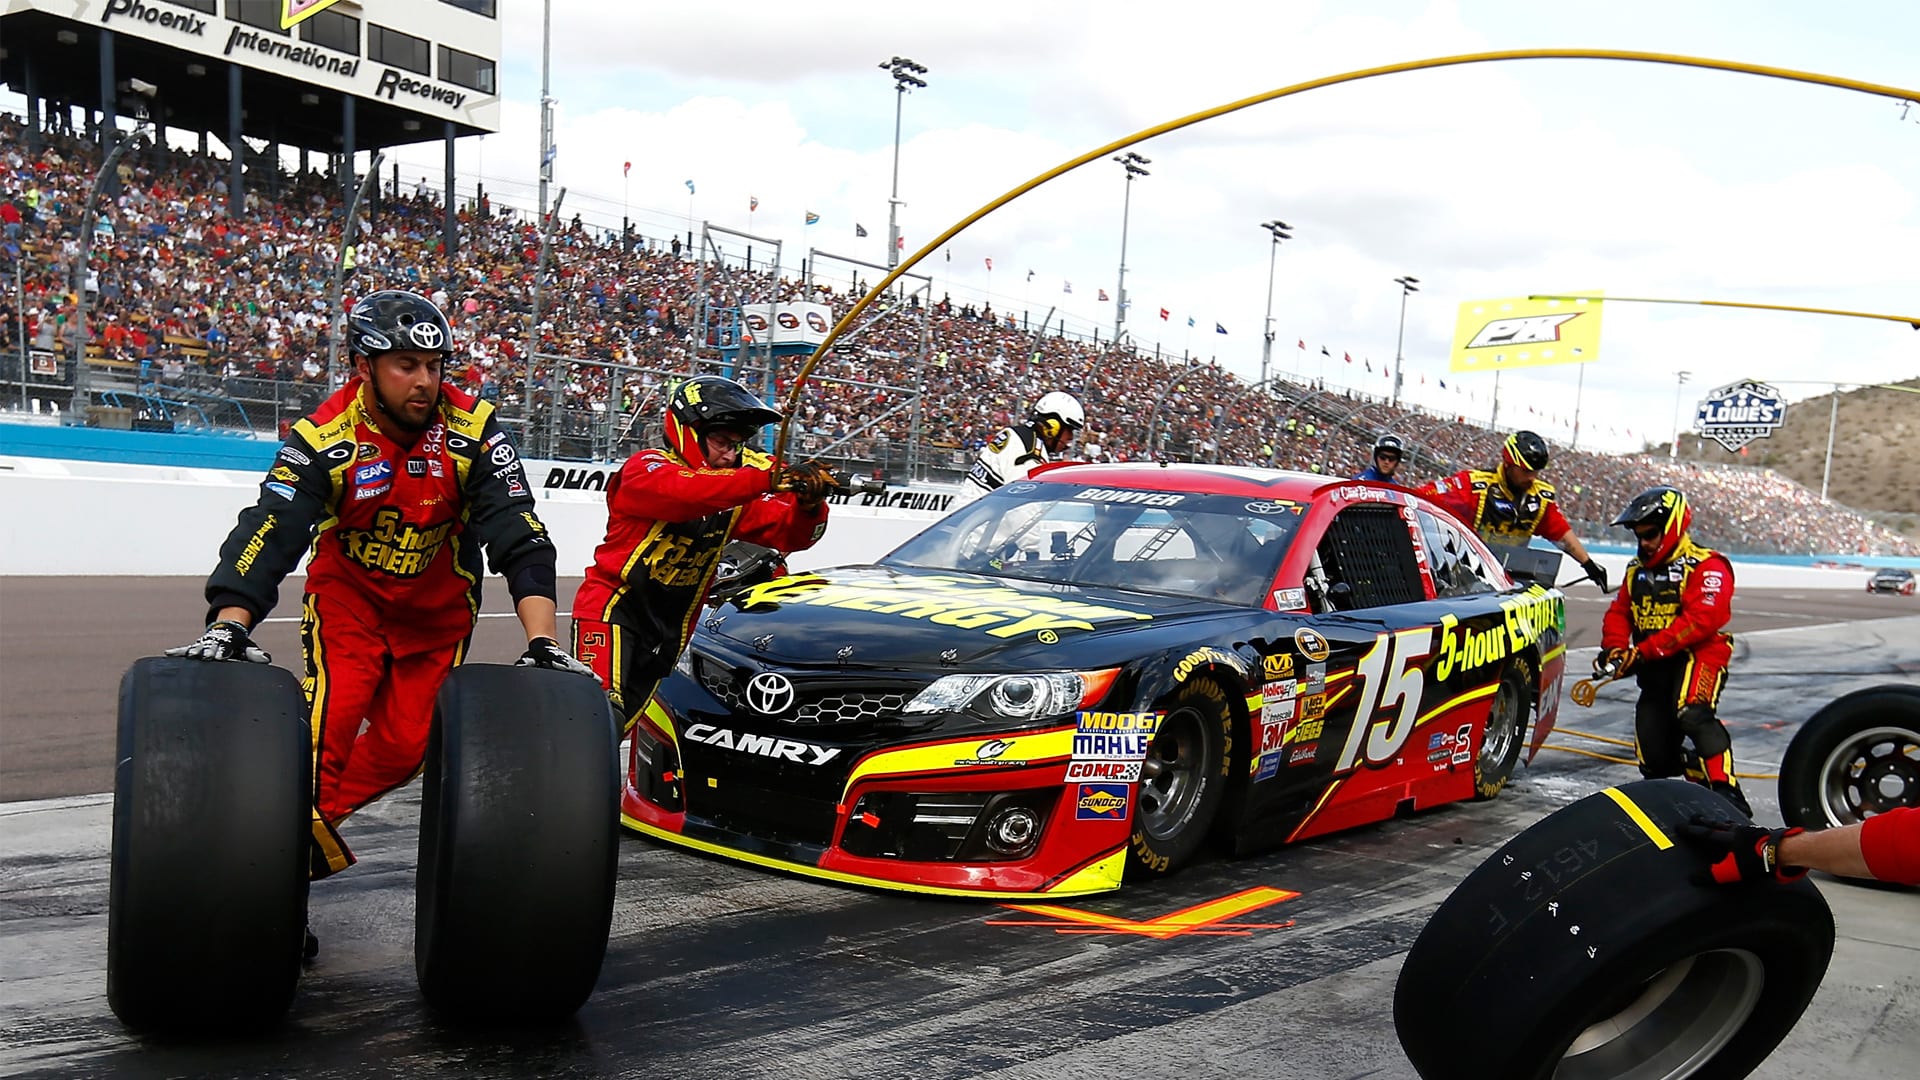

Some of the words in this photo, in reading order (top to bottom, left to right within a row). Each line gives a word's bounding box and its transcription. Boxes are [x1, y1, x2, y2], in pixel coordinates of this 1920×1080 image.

[101, 0, 207, 37] Phoenix
[224, 26, 360, 78] International
[375, 68, 467, 109] Raceway
[1706, 403, 1774, 422] LOWE'S
[1073, 488, 1186, 507] BOWYER
[234, 534, 265, 577] ENERGY
[1436, 613, 1506, 682] 5-hour
[1334, 625, 1434, 772] 15
[1080, 711, 1156, 730] MOOG
[683, 723, 842, 766] CAMRY
[1073, 735, 1147, 755] MAHLE
[1262, 722, 1288, 752] 3M
[1068, 763, 1126, 778] COMP
[1080, 797, 1126, 808] SUNOCO
[1132, 829, 1170, 872] EAGLE
